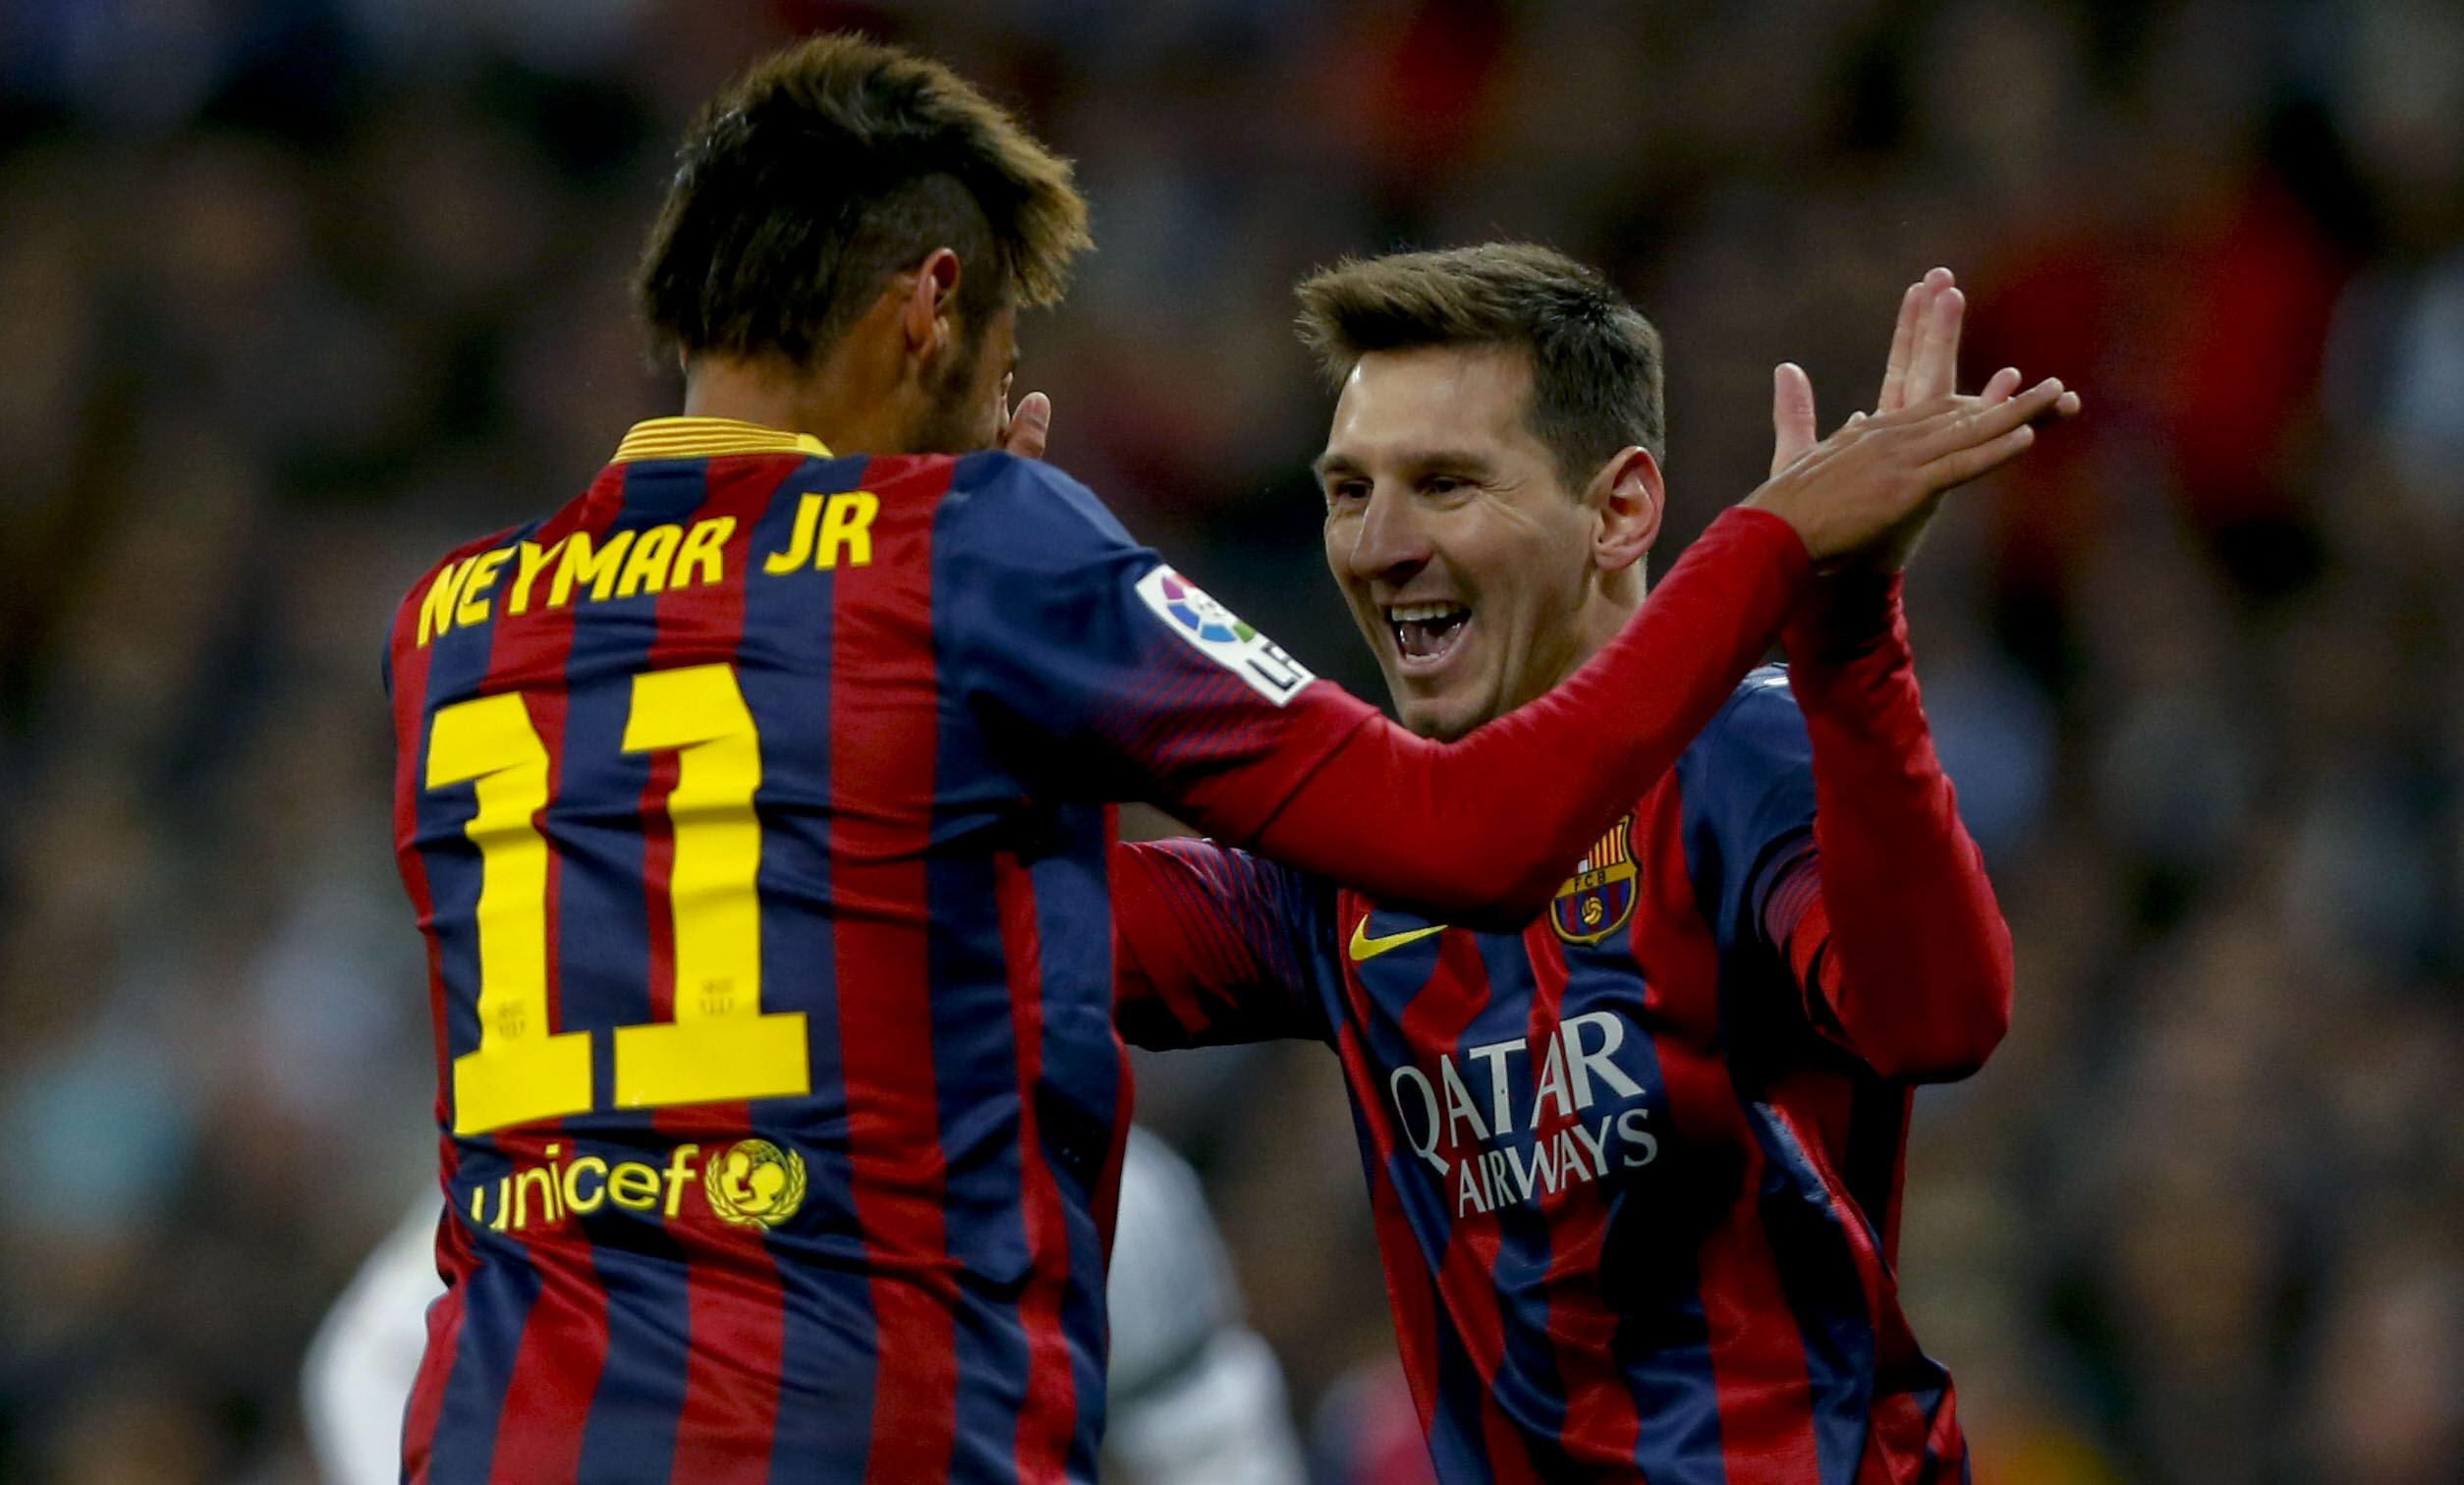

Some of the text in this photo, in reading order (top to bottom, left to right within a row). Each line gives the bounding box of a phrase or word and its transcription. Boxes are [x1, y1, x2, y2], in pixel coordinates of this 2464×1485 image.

[417, 490, 880, 648] NEYMAR JR
[424, 662, 811, 1135] 11
[1390, 1011, 1647, 1176] QATAR
[1458, 1109, 1658, 1218] AIRWAYS
[470, 1143, 700, 1234] unicef
